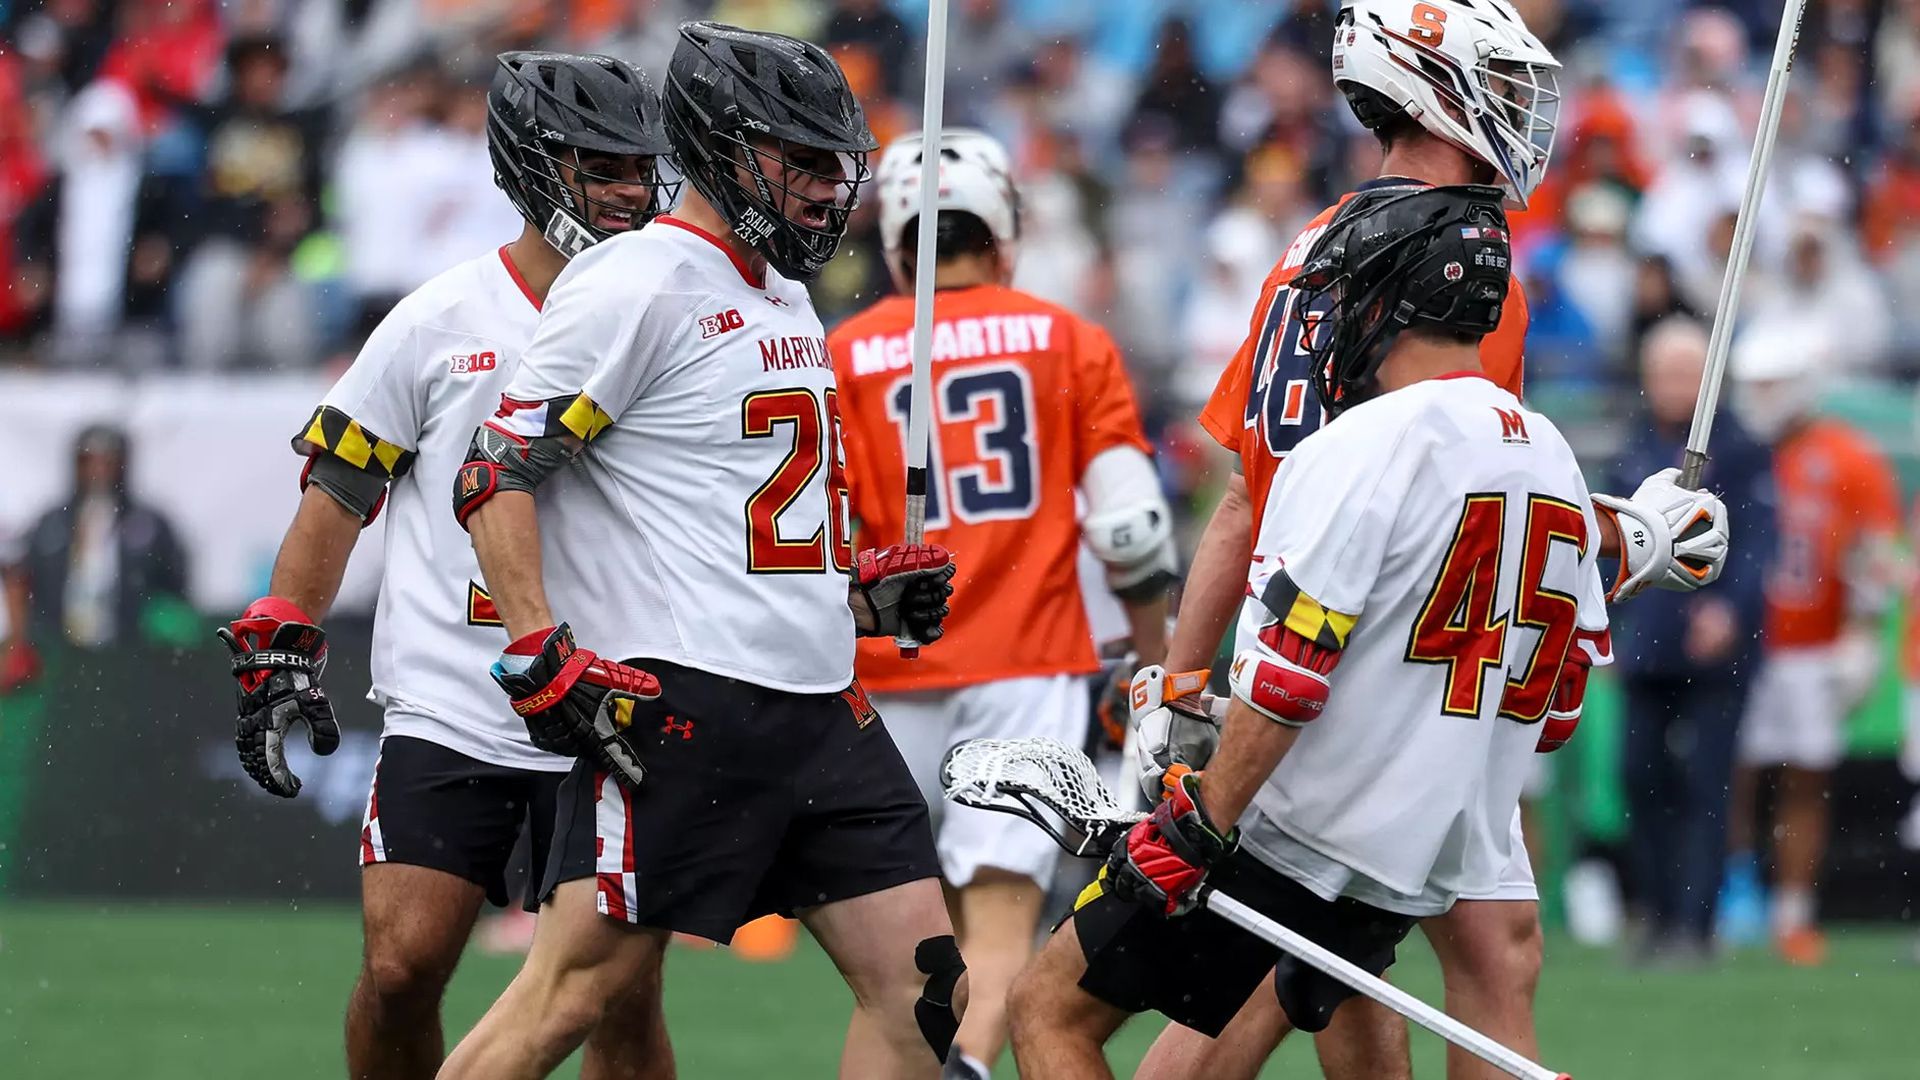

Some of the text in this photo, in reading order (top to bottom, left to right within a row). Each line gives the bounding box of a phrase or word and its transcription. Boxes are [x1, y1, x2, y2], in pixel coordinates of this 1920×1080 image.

[1408, 2, 1447, 49] S
[734, 222, 761, 247] 23:4
[740, 207, 777, 239] PSALM
[1475, 254, 1484, 266] BE
[1485, 255, 1496, 267] THE
[758, 336, 833, 372] MARYLA
[1244, 285, 1338, 458] 48
[885, 362, 1041, 533] 13
[462, 467, 479, 495] M
[1633, 530, 1646, 548] 48
[1403, 492, 1588, 725] 45
